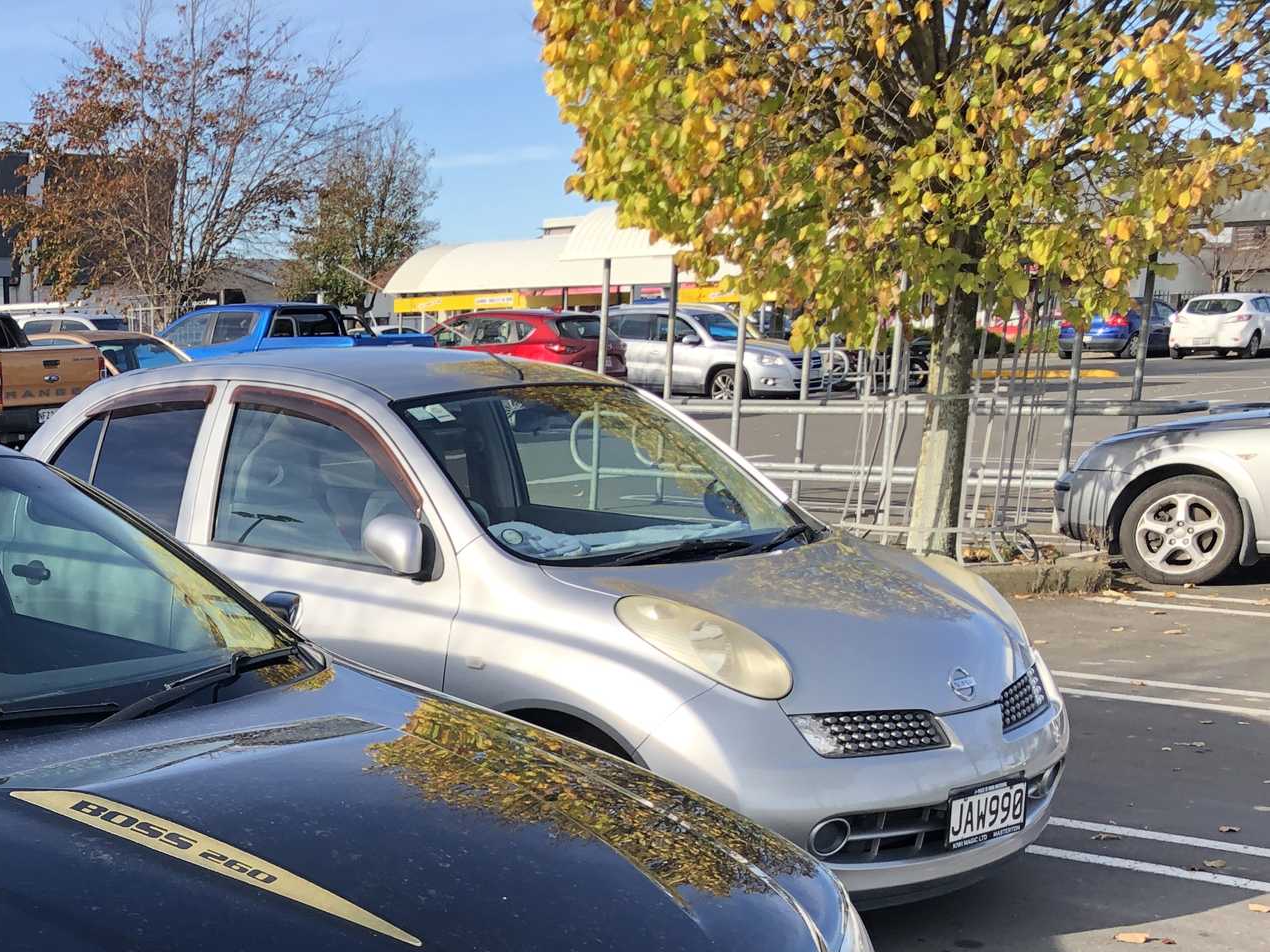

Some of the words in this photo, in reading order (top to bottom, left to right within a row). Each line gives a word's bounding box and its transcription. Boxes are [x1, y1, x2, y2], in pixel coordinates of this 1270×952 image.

[5, 387, 82, 399] RANGE
[951, 789, 1023, 836] JAW990
[69, 800, 198, 850] BOSS
[198, 849, 278, 884] 260
[978, 834, 988, 842] LTD
